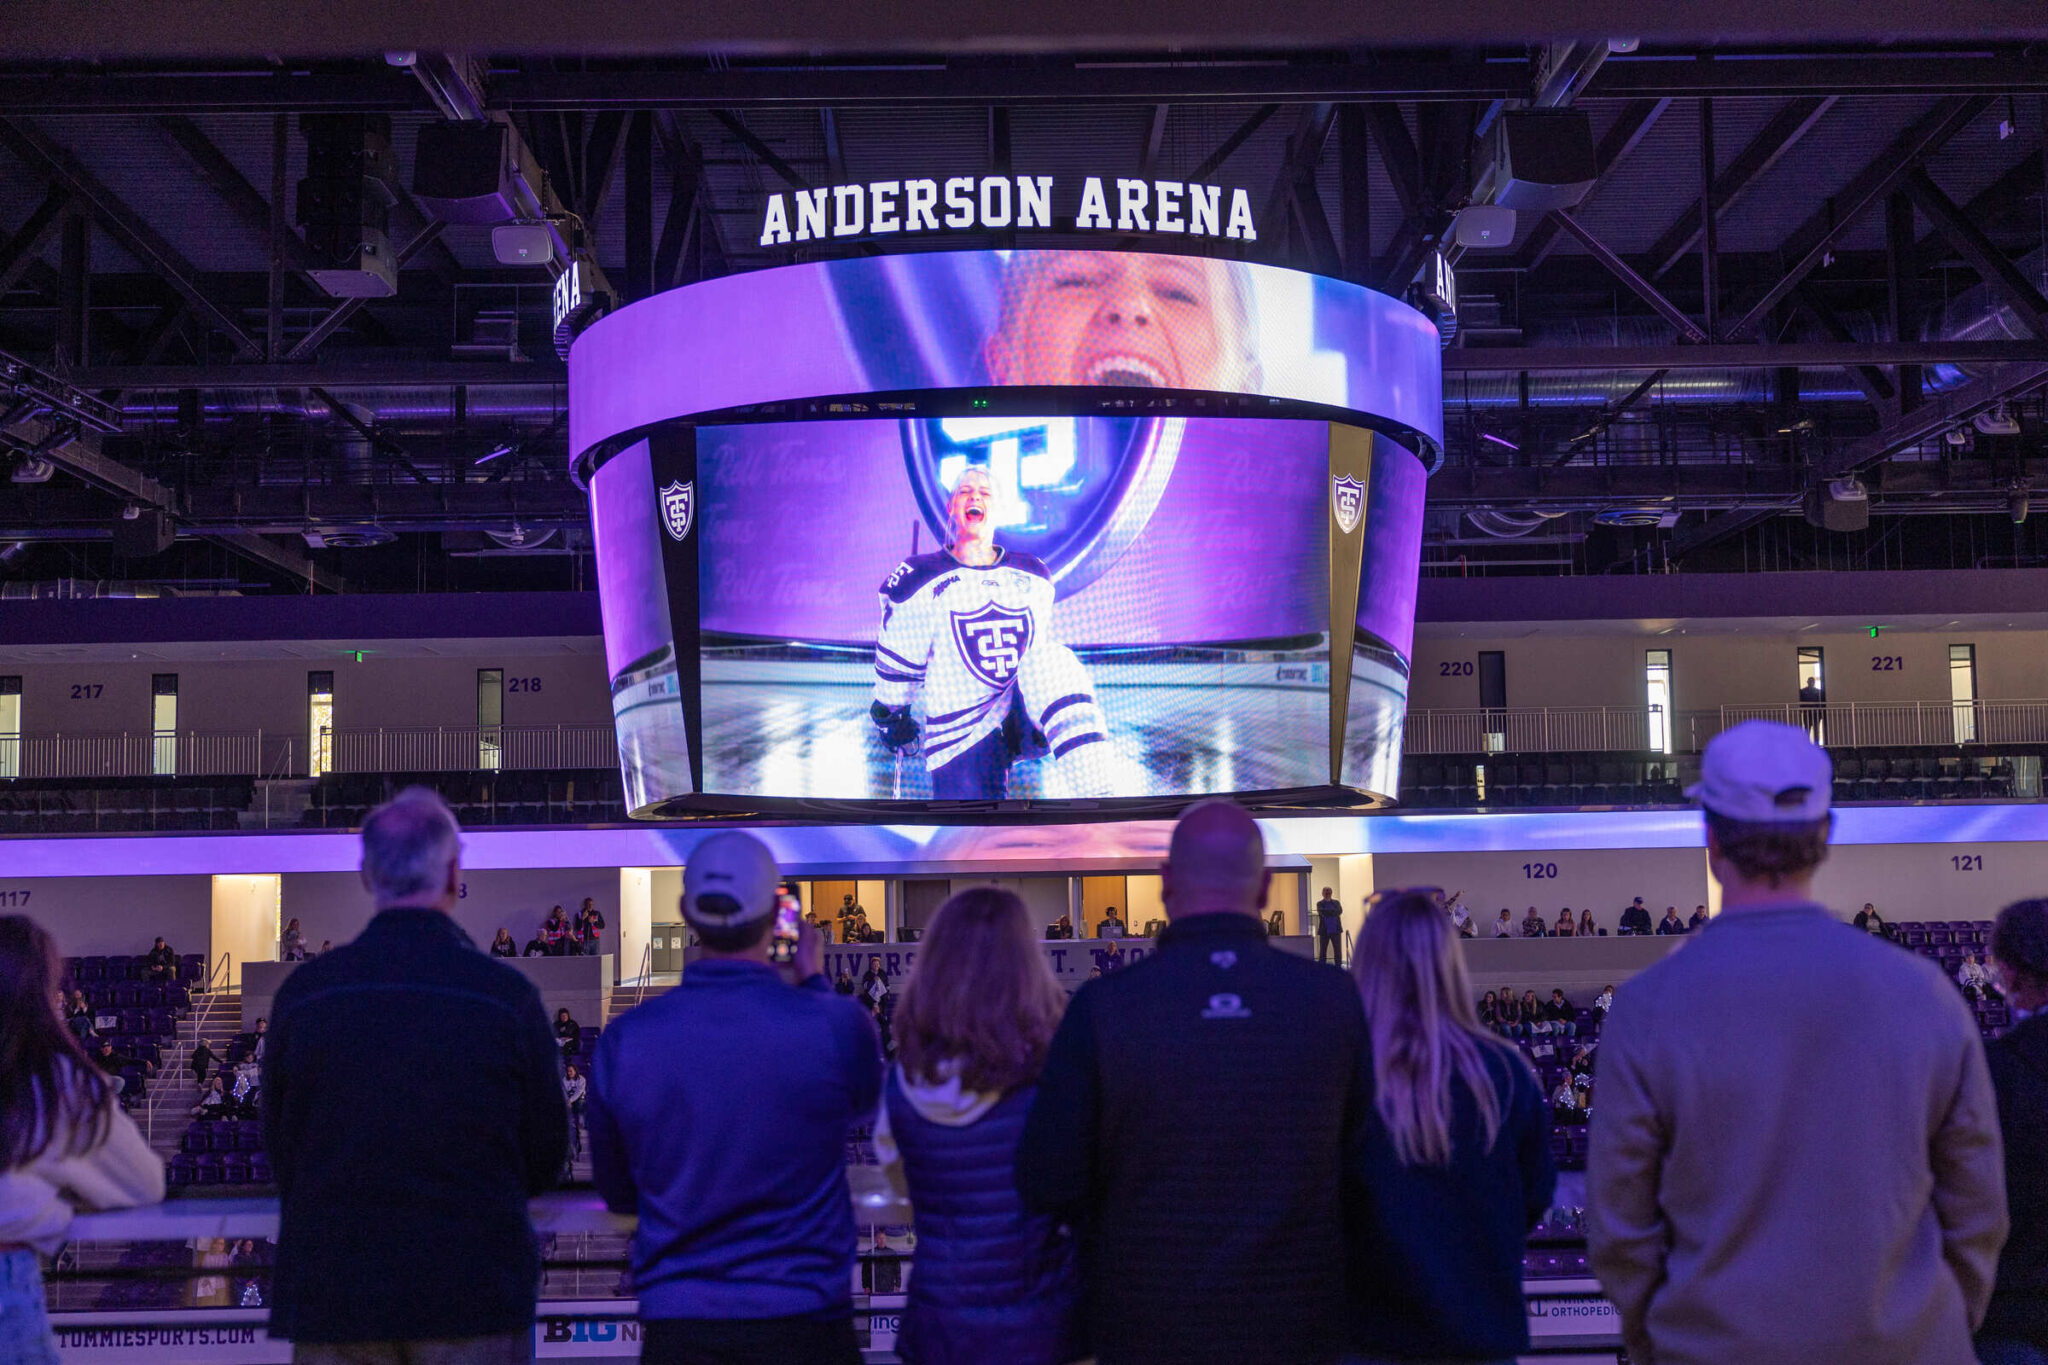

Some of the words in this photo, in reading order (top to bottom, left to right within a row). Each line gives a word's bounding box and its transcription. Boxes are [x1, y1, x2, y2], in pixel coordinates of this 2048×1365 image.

[760, 176, 1053, 246] ANDERSON
[1075, 177, 1257, 240] ARENA
[553, 261, 581, 337] ENA
[1440, 662, 1473, 676] 220
[1871, 656, 1902, 671] 221
[71, 684, 104, 699] 217
[508, 677, 541, 692] 218
[1522, 863, 1557, 879] 120
[1951, 855, 1982, 871] 121
[59, 1328, 255, 1348] TOMMIESPORTS.COM
